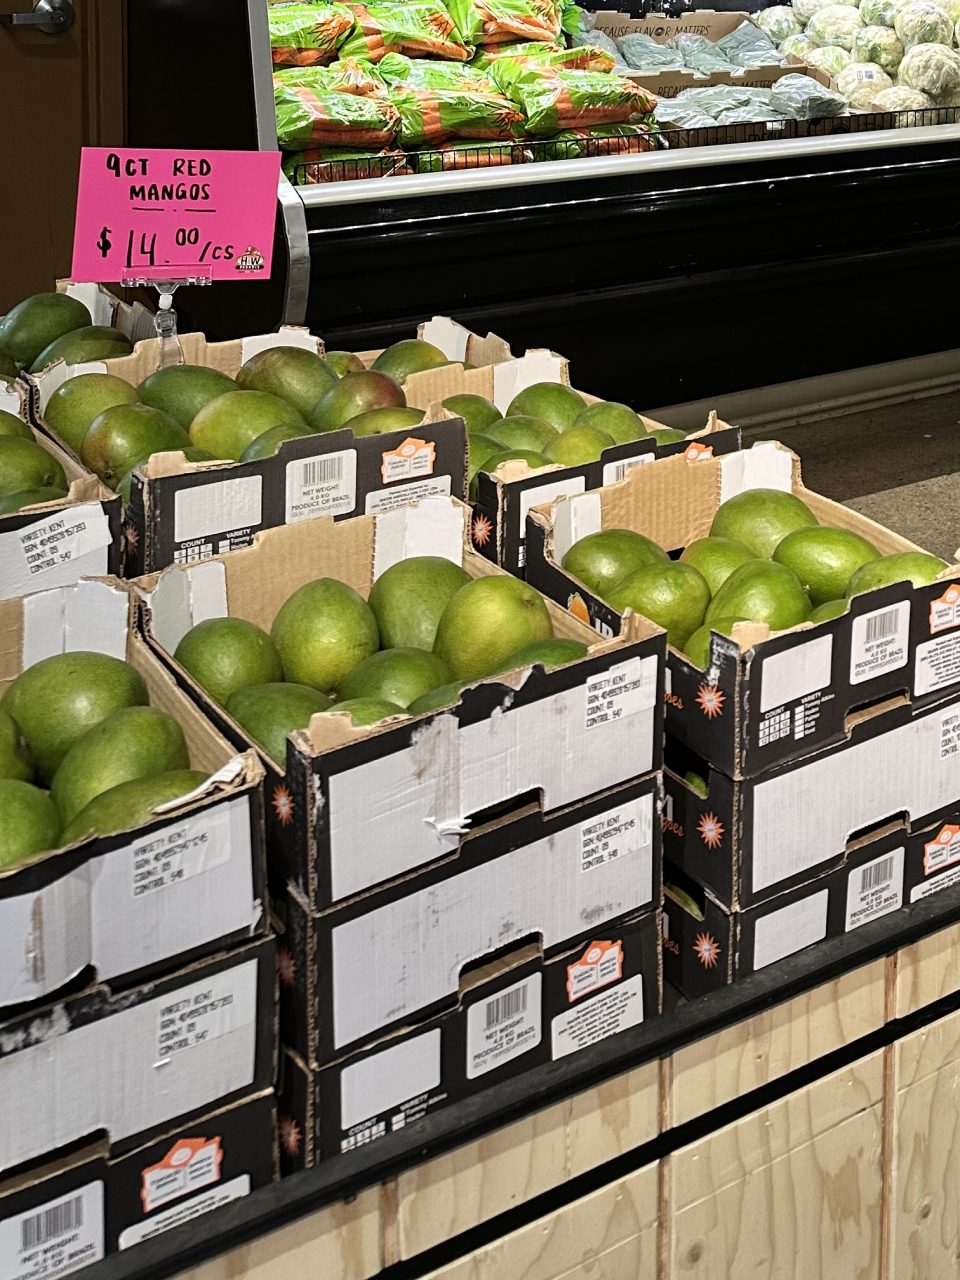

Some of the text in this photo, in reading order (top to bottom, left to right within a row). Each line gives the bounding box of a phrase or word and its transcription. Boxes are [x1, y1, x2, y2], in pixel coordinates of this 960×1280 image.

[675, 25, 712, 36] MATTERS
[106, 153, 211, 177] 9CT RED
[129, 183, 210, 201] MANGOS
[97, 227, 112, 258] $
[291, 501, 319, 511] PRODUCE
[49, 520, 65, 532] KENT
[226, 529, 251, 538] VARIETY
[181, 538, 206, 549] COUNT
[801, 692, 821, 704] VARIETY
[765, 706, 785, 719] COUNT
